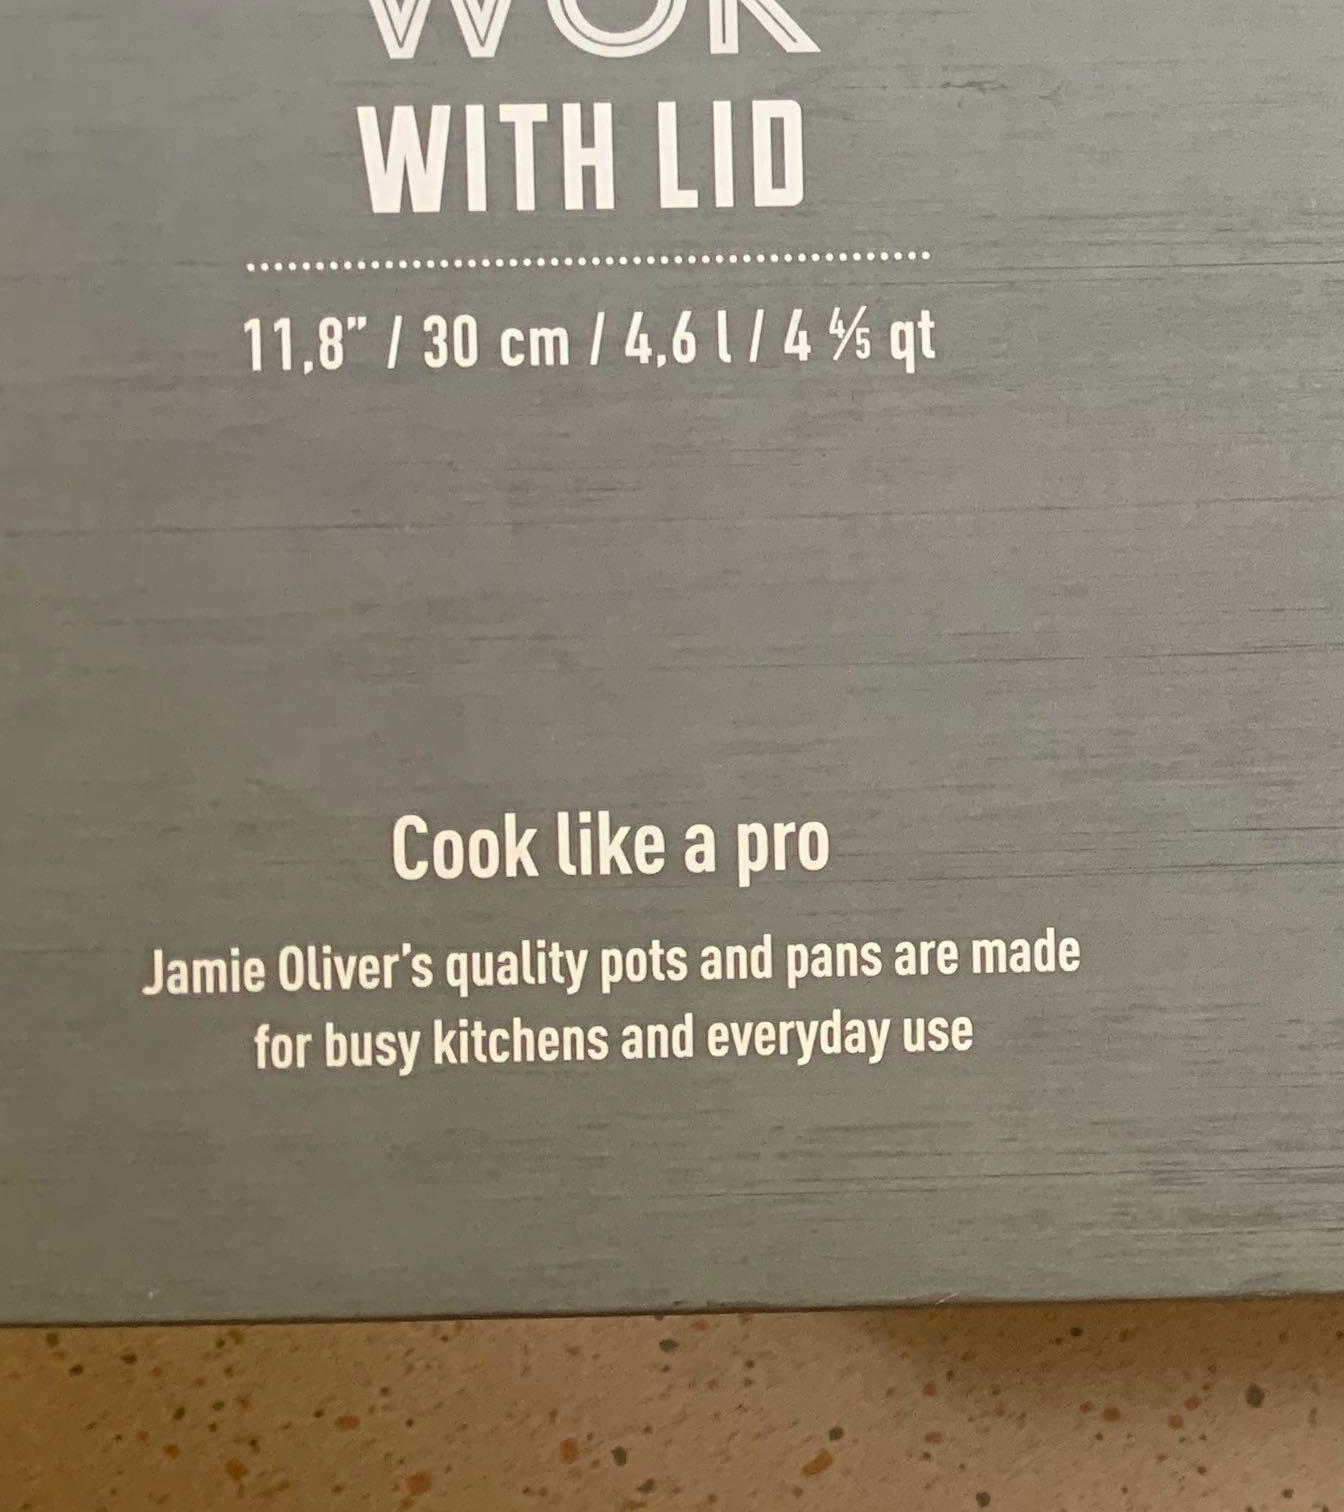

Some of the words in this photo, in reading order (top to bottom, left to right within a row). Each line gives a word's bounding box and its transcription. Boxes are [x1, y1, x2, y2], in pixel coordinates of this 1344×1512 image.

[356, 101, 615, 214] WITH
[657, 99, 804, 209] LID
[387, 314, 403, 369] /
[423, 313, 478, 368] 30
[500, 326, 570, 367] cm
[589, 311, 605, 366] /
[624, 310, 697, 368] 4,6
[749, 308, 765, 363] /
[783, 308, 812, 362] 4
[890, 309, 936, 374] qt
[393, 812, 539, 880] Cook
[557, 810, 665, 876] like
[684, 823, 716, 873] a
[737, 821, 829, 888] pro
[142, 947, 266, 995] Jamie
[446, 939, 589, 998] quality
[601, 939, 688, 993] pots
[700, 933, 773, 981] and
[787, 941, 883, 989] pans
[894, 940, 959, 976] are
[972, 926, 1081, 974] made
[254, 1023, 313, 1069] for
[325, 1021, 421, 1076] busy
[433, 1017, 609, 1064] kitchens
[621, 1012, 694, 1060] and
[707, 1009, 891, 1066] everyday
[903, 1016, 973, 1053] use
